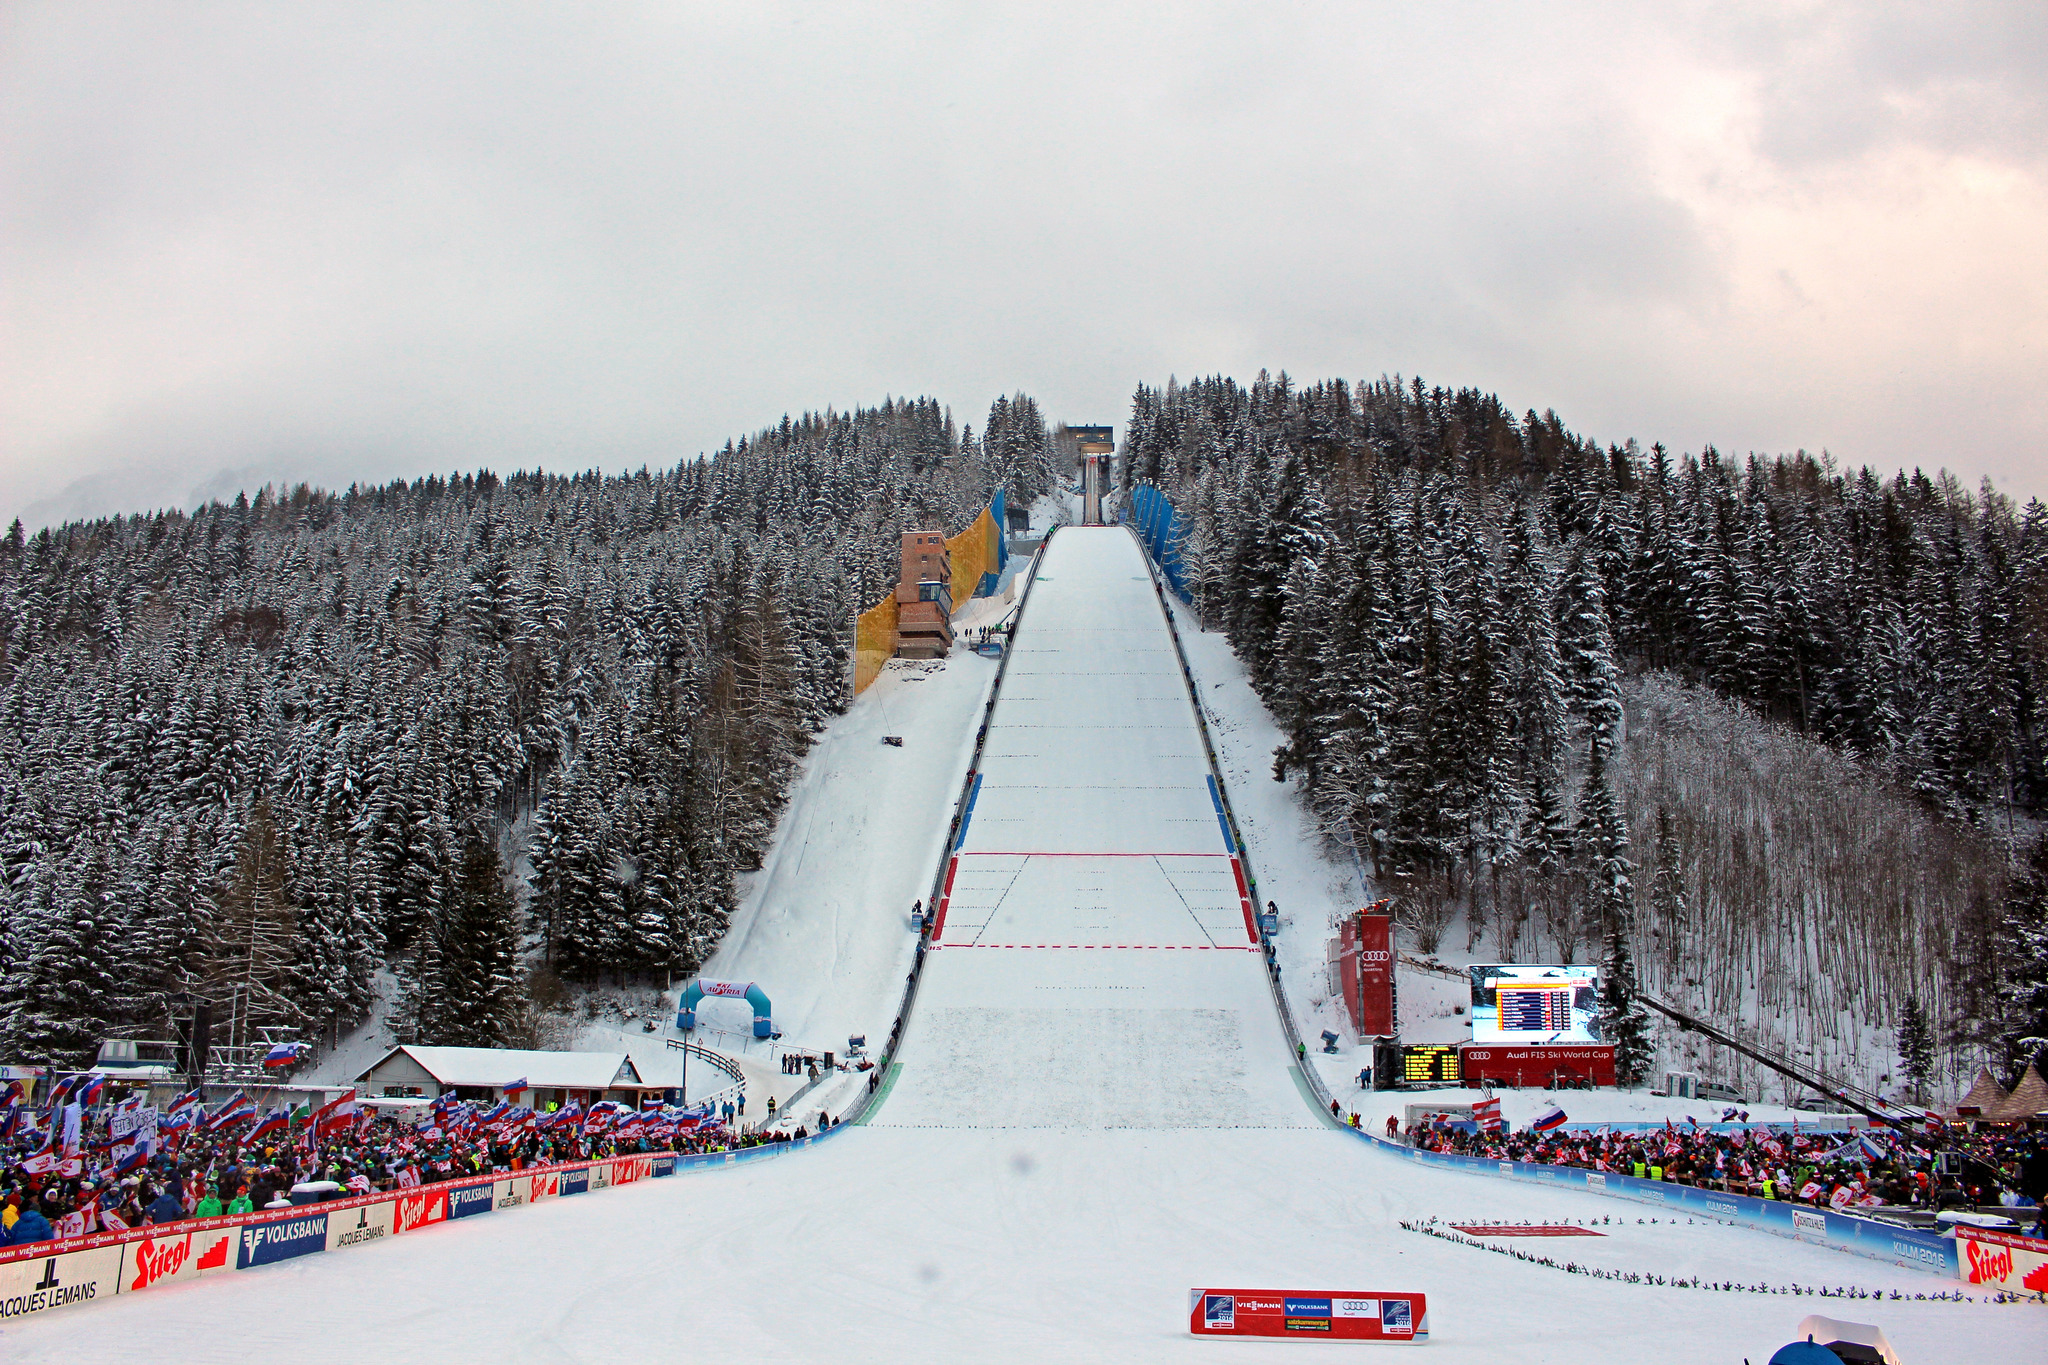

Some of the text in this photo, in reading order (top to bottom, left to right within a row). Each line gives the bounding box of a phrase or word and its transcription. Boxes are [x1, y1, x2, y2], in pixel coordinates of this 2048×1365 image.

[1506, 1051, 1610, 1060] Audi FIS Ski World Cup
[460, 1185, 493, 1203] VOLKSBANK
[399, 1194, 426, 1233] Stiegl
[266, 1217, 326, 1244] VOLKSBANK
[337, 1225, 385, 1248] JACQUES LEMANS
[131, 1233, 192, 1291] Stiegl
[1893, 1241, 1919, 1261] KULM
[1919, 1248, 1946, 1269] 2016
[1966, 1240, 2013, 1285] Stiegl
[0, 1281, 97, 1318] ACQUES LEMANS
[1237, 1300, 1281, 1311] VIESSMANN
[1287, 1319, 1329, 1327] salzkammergut
